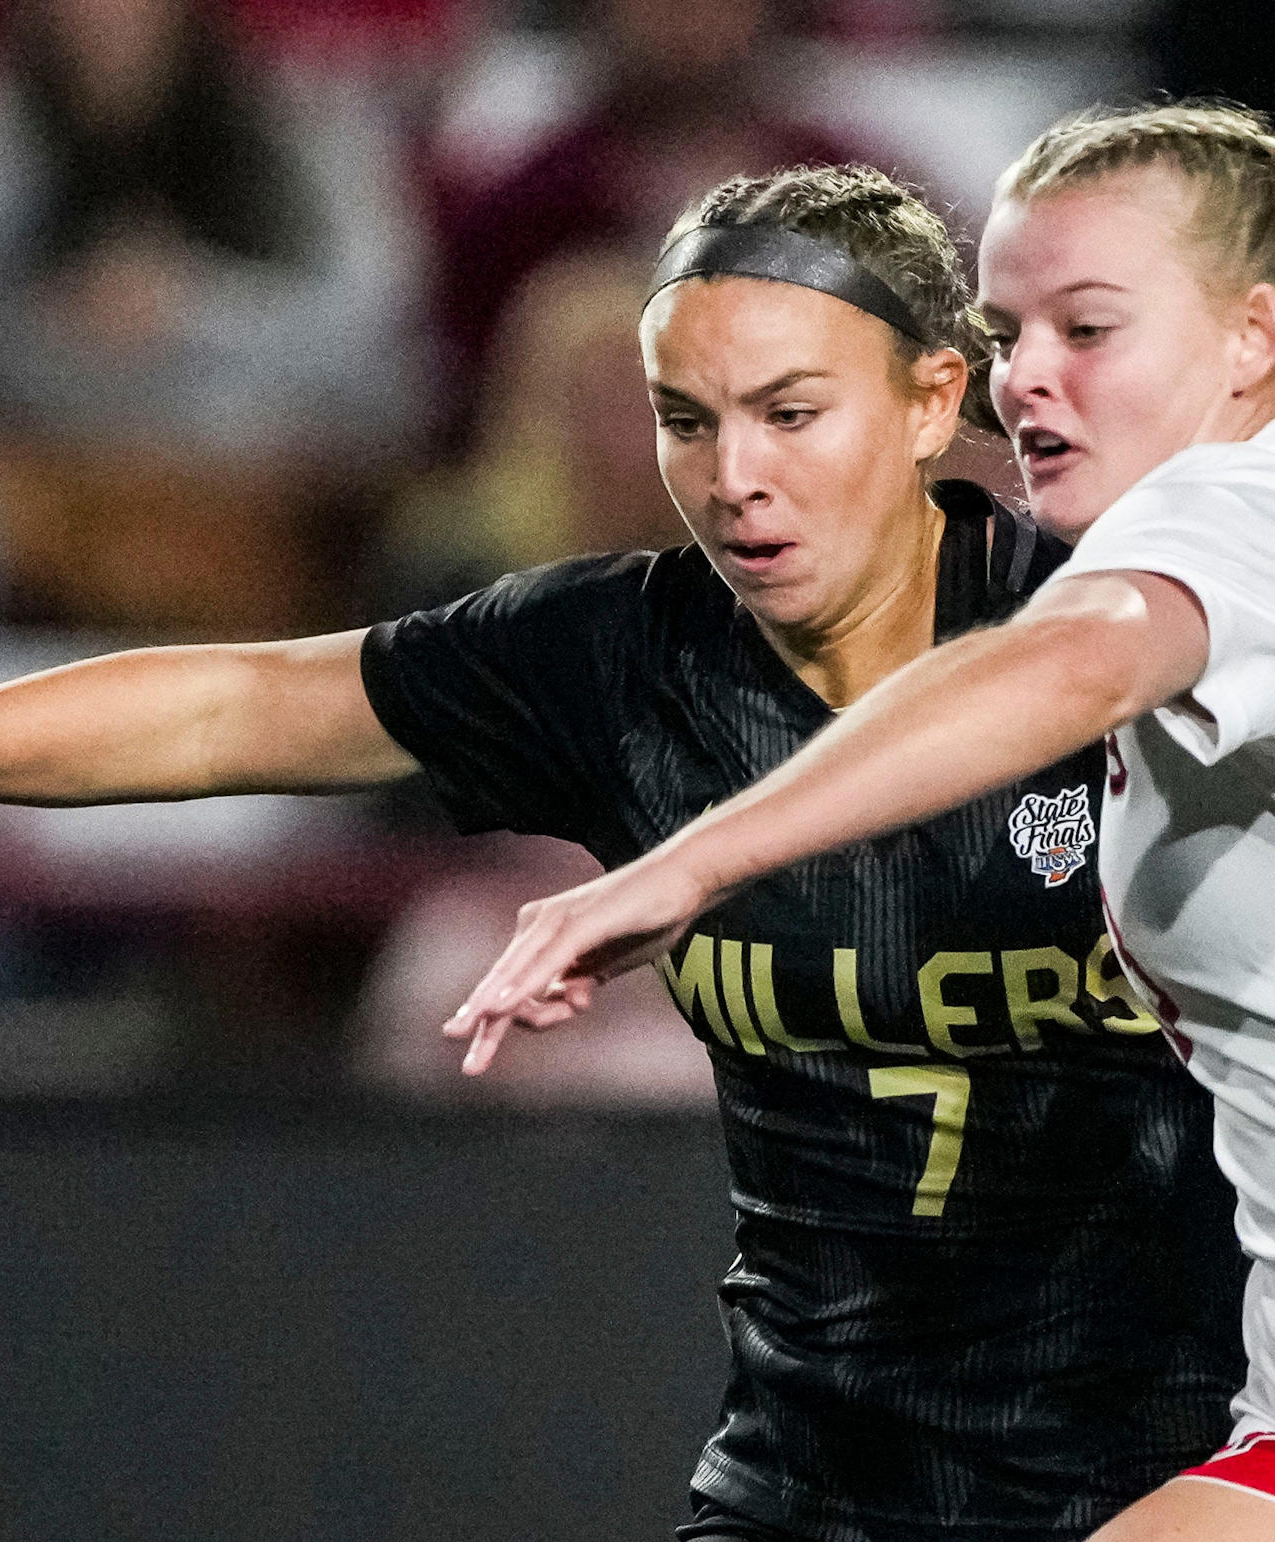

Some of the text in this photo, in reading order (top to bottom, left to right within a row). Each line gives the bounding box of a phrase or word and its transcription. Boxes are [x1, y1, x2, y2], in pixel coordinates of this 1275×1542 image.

[1013, 787, 1086, 825] State
[1014, 815, 1093, 855] Finals
[655, 932, 1161, 1058] MILLERS
[868, 1064, 971, 1217] 7
